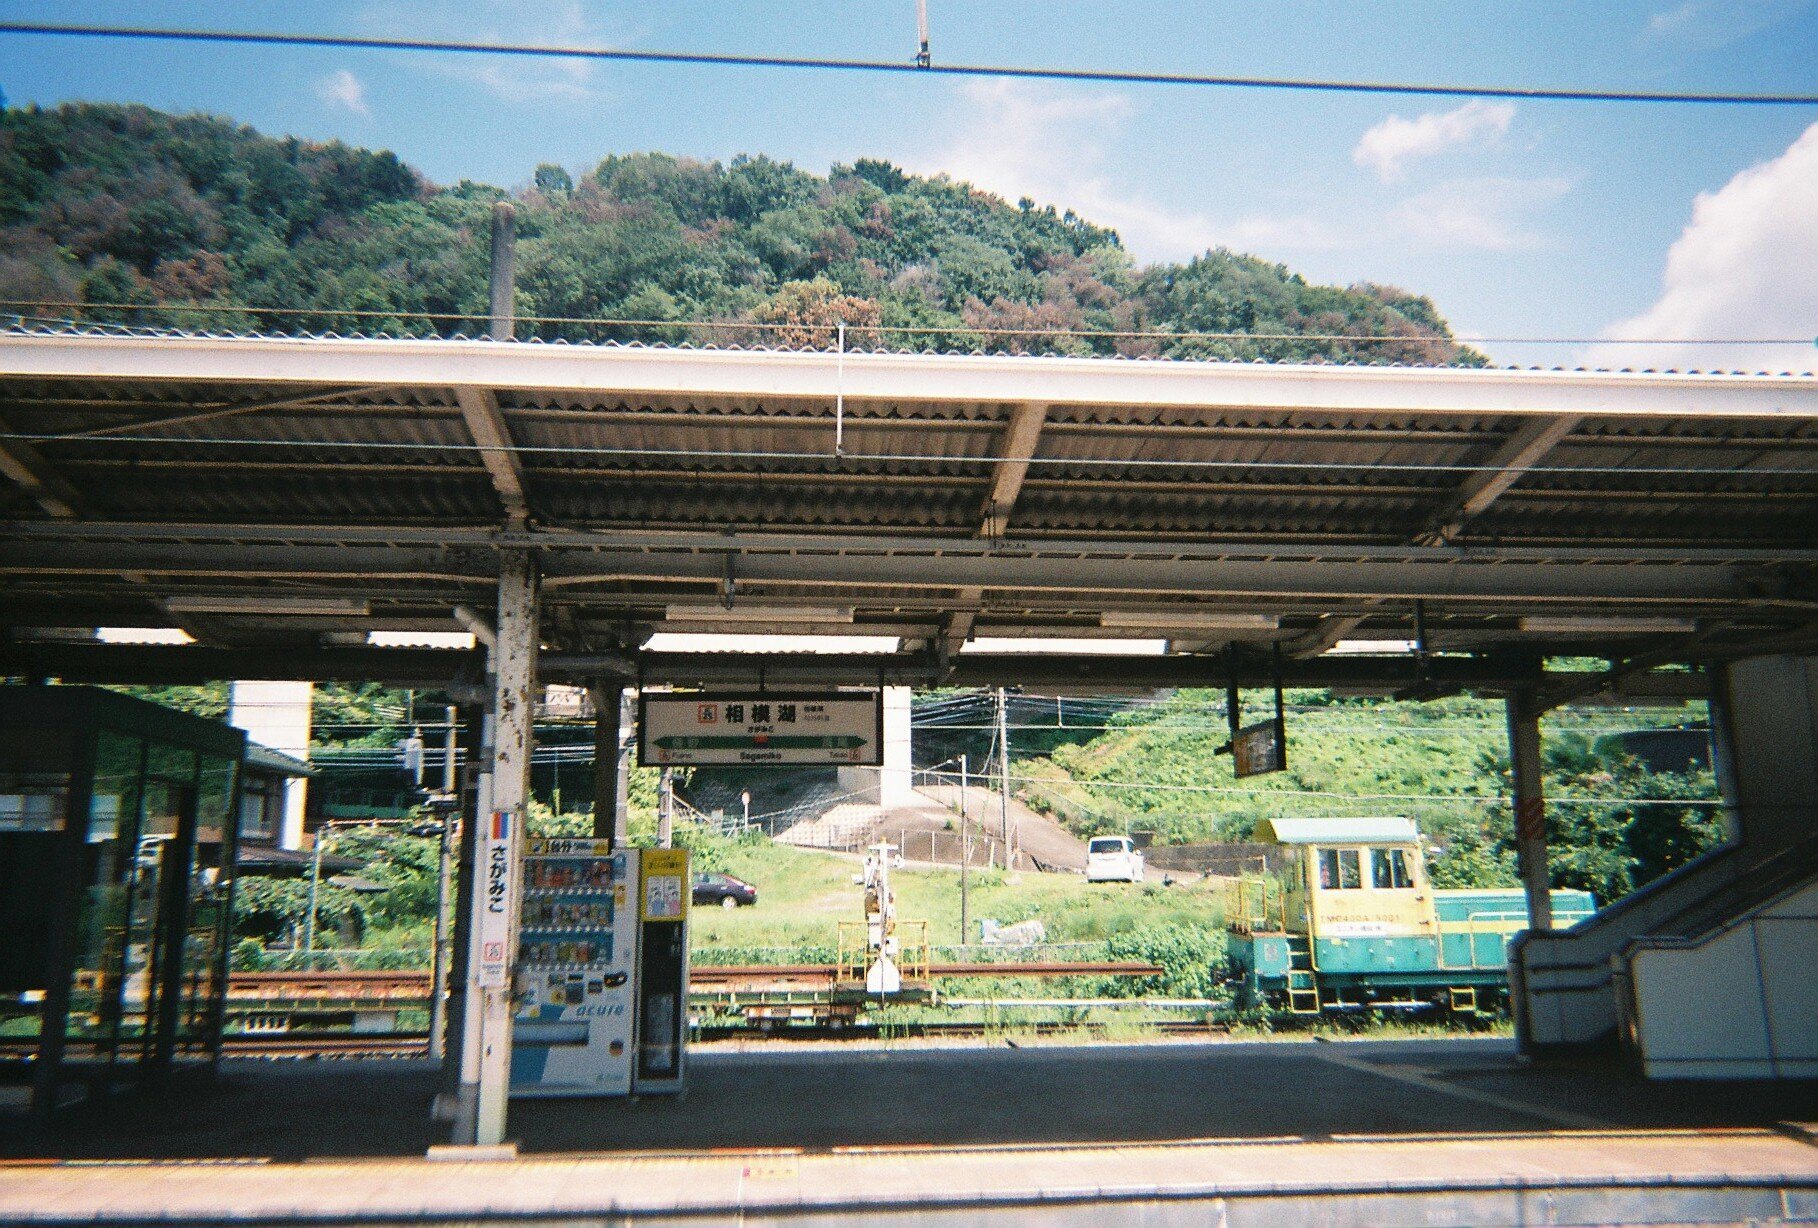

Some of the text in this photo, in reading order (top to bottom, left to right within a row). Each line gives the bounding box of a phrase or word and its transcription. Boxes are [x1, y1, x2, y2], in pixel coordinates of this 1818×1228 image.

[725, 704, 796, 723] 相模湖
[740, 751, 782, 762] Sagamiko
[489, 845, 507, 913] さがみこ
[576, 1004, 624, 1016] acure
